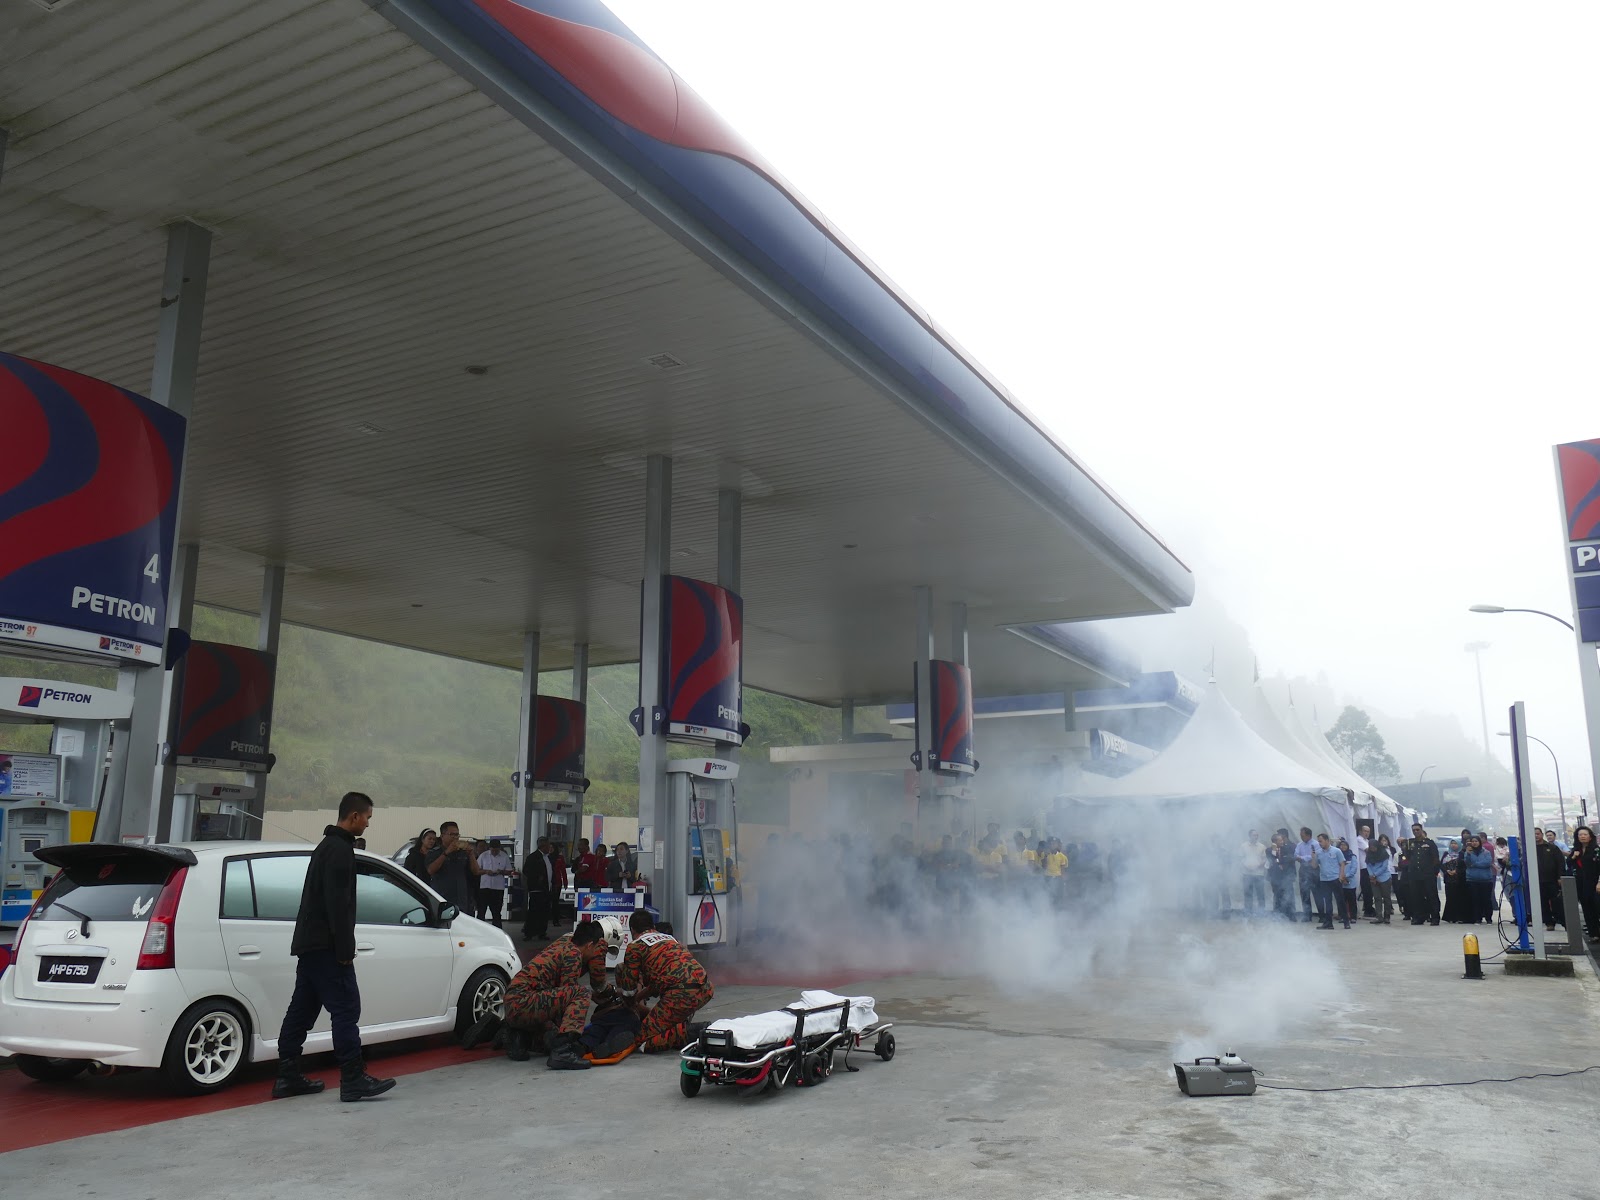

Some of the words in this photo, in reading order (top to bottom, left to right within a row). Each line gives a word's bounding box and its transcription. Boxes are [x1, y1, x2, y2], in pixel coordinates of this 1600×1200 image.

[144, 553, 160, 584] 4
[71, 586, 156, 625] PETRON
[26, 625, 37, 636] 97
[111, 639, 134, 650] PETRON
[134, 645, 142, 655] 95
[43, 688, 92, 704] PETRON
[634, 714, 640, 722] 7
[655, 712, 661, 720] 8
[260, 721, 266, 736] 6
[230, 741, 264, 754] PETRON
[619, 915, 629, 925] 97
[623, 933, 629, 944] 5
